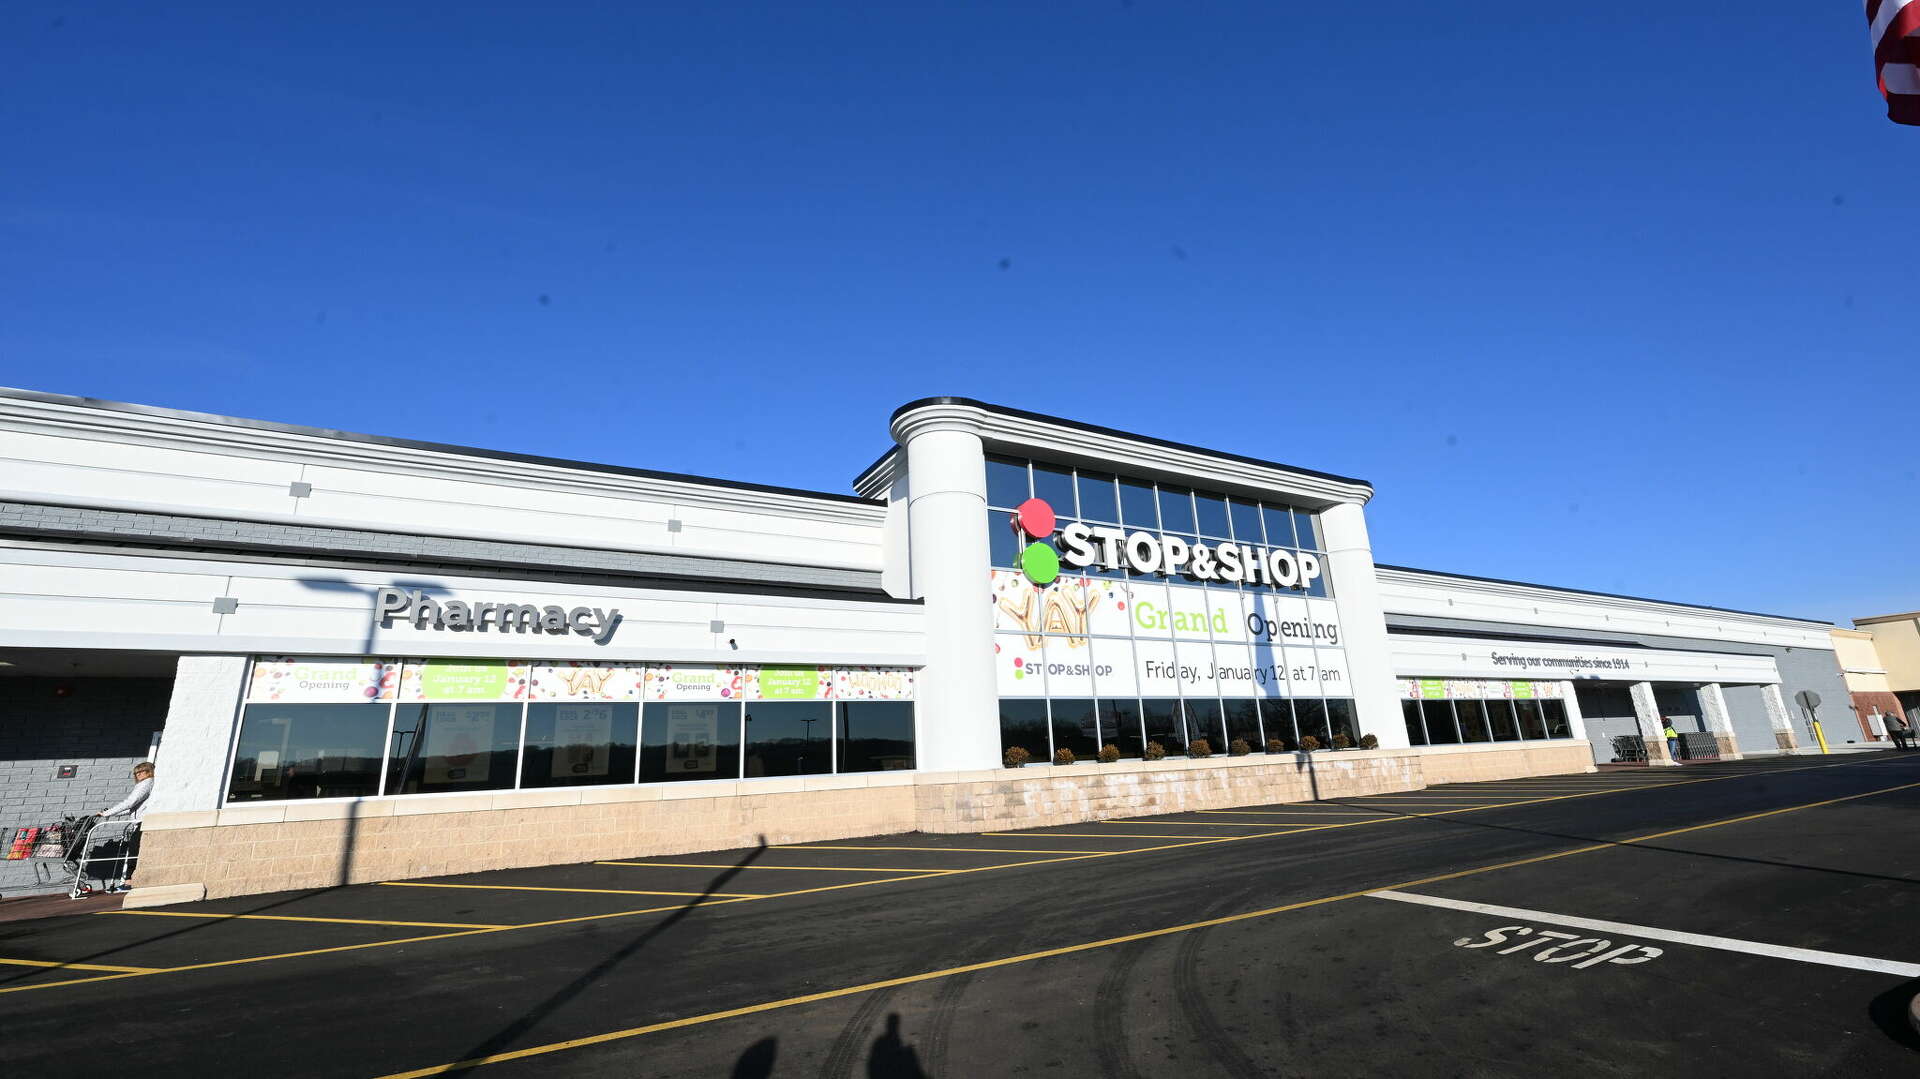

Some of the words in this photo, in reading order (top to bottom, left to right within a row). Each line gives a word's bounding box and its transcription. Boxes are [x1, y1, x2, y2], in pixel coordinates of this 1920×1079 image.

[1063, 522, 1320, 588] STOP&SHOP
[375, 587, 622, 643] Pharmacy
[1000, 585, 1100, 651] YAY
[1135, 601, 1229, 633] Grand
[1247, 612, 1338, 645] Opening
[1025, 663, 1112, 676] STOP&SHOP
[1146, 660, 1200, 684] Friday,
[1207, 661, 1267, 684] January
[1270, 665, 1285, 681] 12
[1293, 667, 1307, 681] at
[1308, 666, 1315, 680] 7
[1321, 670, 1341, 681] am
[1491, 651, 1527, 669] Serving
[1527, 656, 1541, 666] our
[1542, 656, 1593, 669] communities
[1594, 657, 1612, 669] since
[1613, 658, 1630, 669] 1914
[294, 666, 358, 681] Grand
[299, 680, 350, 691] Opening
[558, 670, 614, 695] YAY
[672, 671, 714, 683] Grand
[676, 683, 711, 691] Opening
[1454, 926, 1664, 969] STOP
